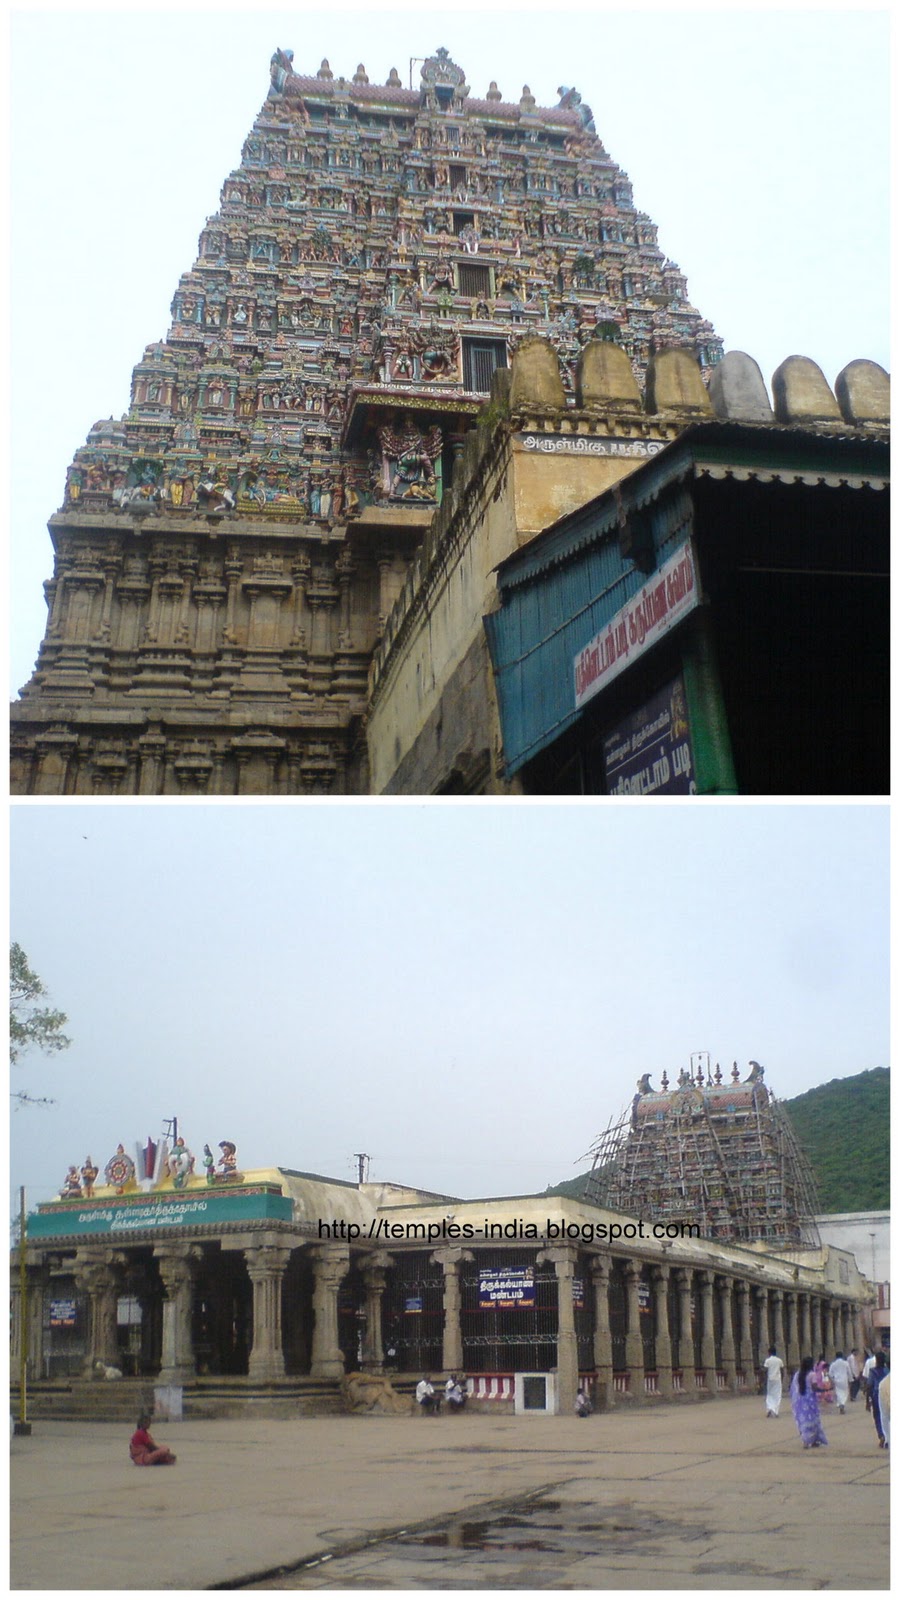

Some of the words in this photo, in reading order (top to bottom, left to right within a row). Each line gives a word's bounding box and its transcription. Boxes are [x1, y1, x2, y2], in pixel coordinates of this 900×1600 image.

[523, 436, 606, 455] அருள்மிகு
[671, 742, 692, 778] படி
[490, 1289, 524, 1300] மண்டபம்
